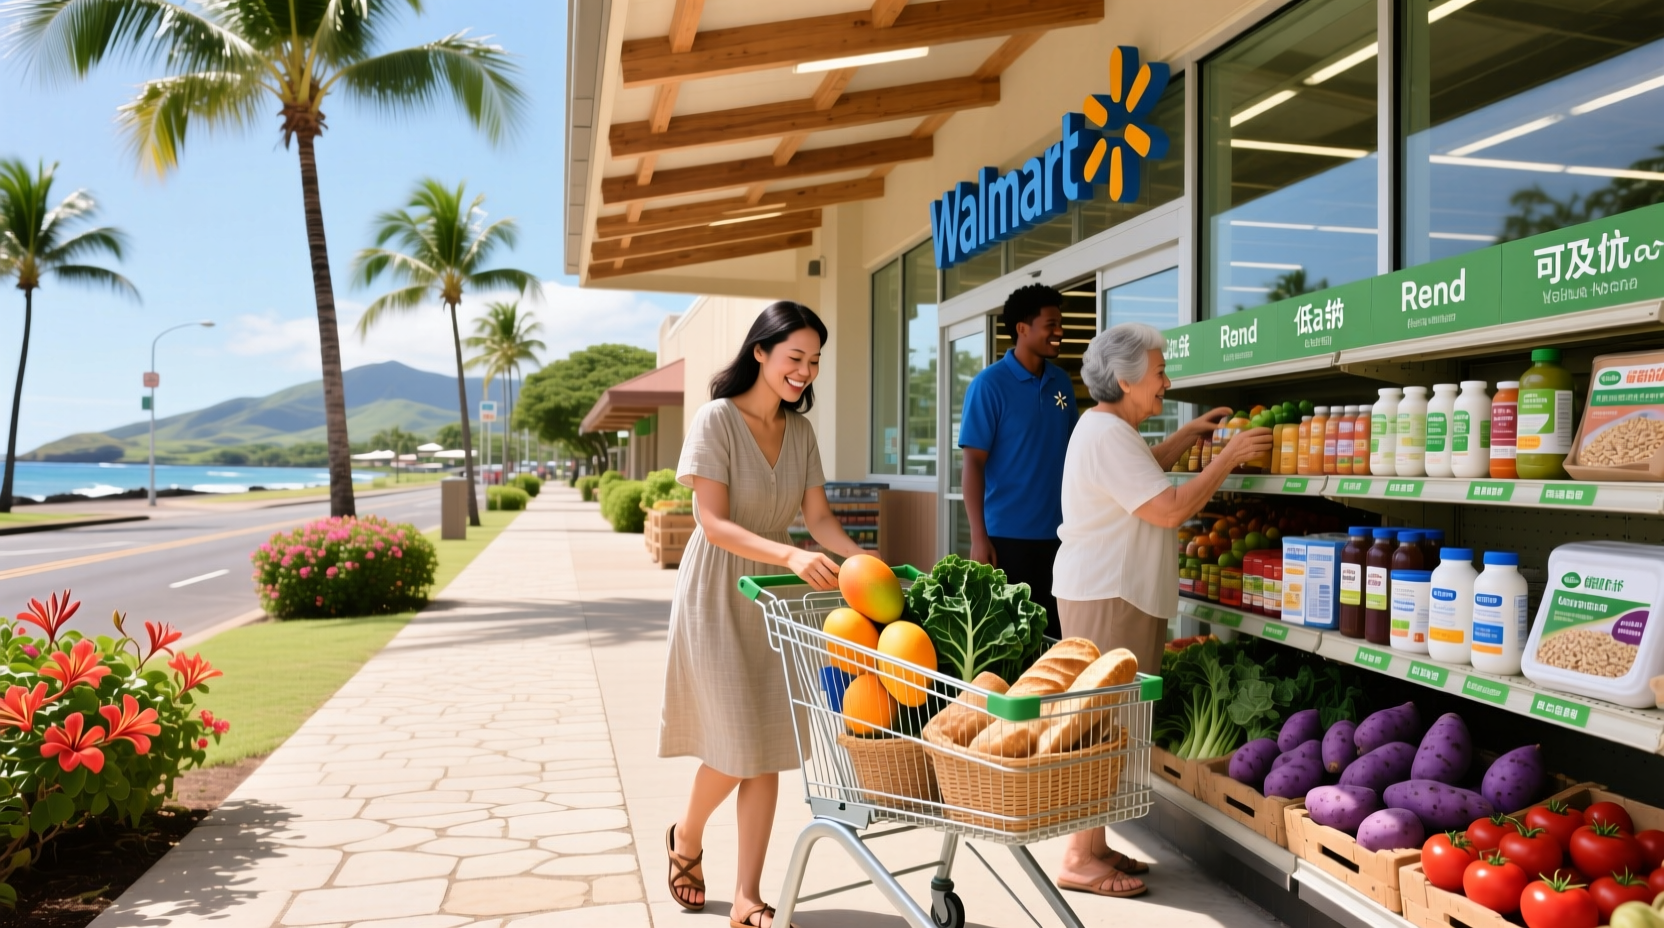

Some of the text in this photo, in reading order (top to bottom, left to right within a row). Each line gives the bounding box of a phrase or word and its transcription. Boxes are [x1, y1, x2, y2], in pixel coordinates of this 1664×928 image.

[930, 112, 1079, 269] Walmart
[1401, 267, 1466, 312] Rend
[1220, 318, 1258, 349] Rend
